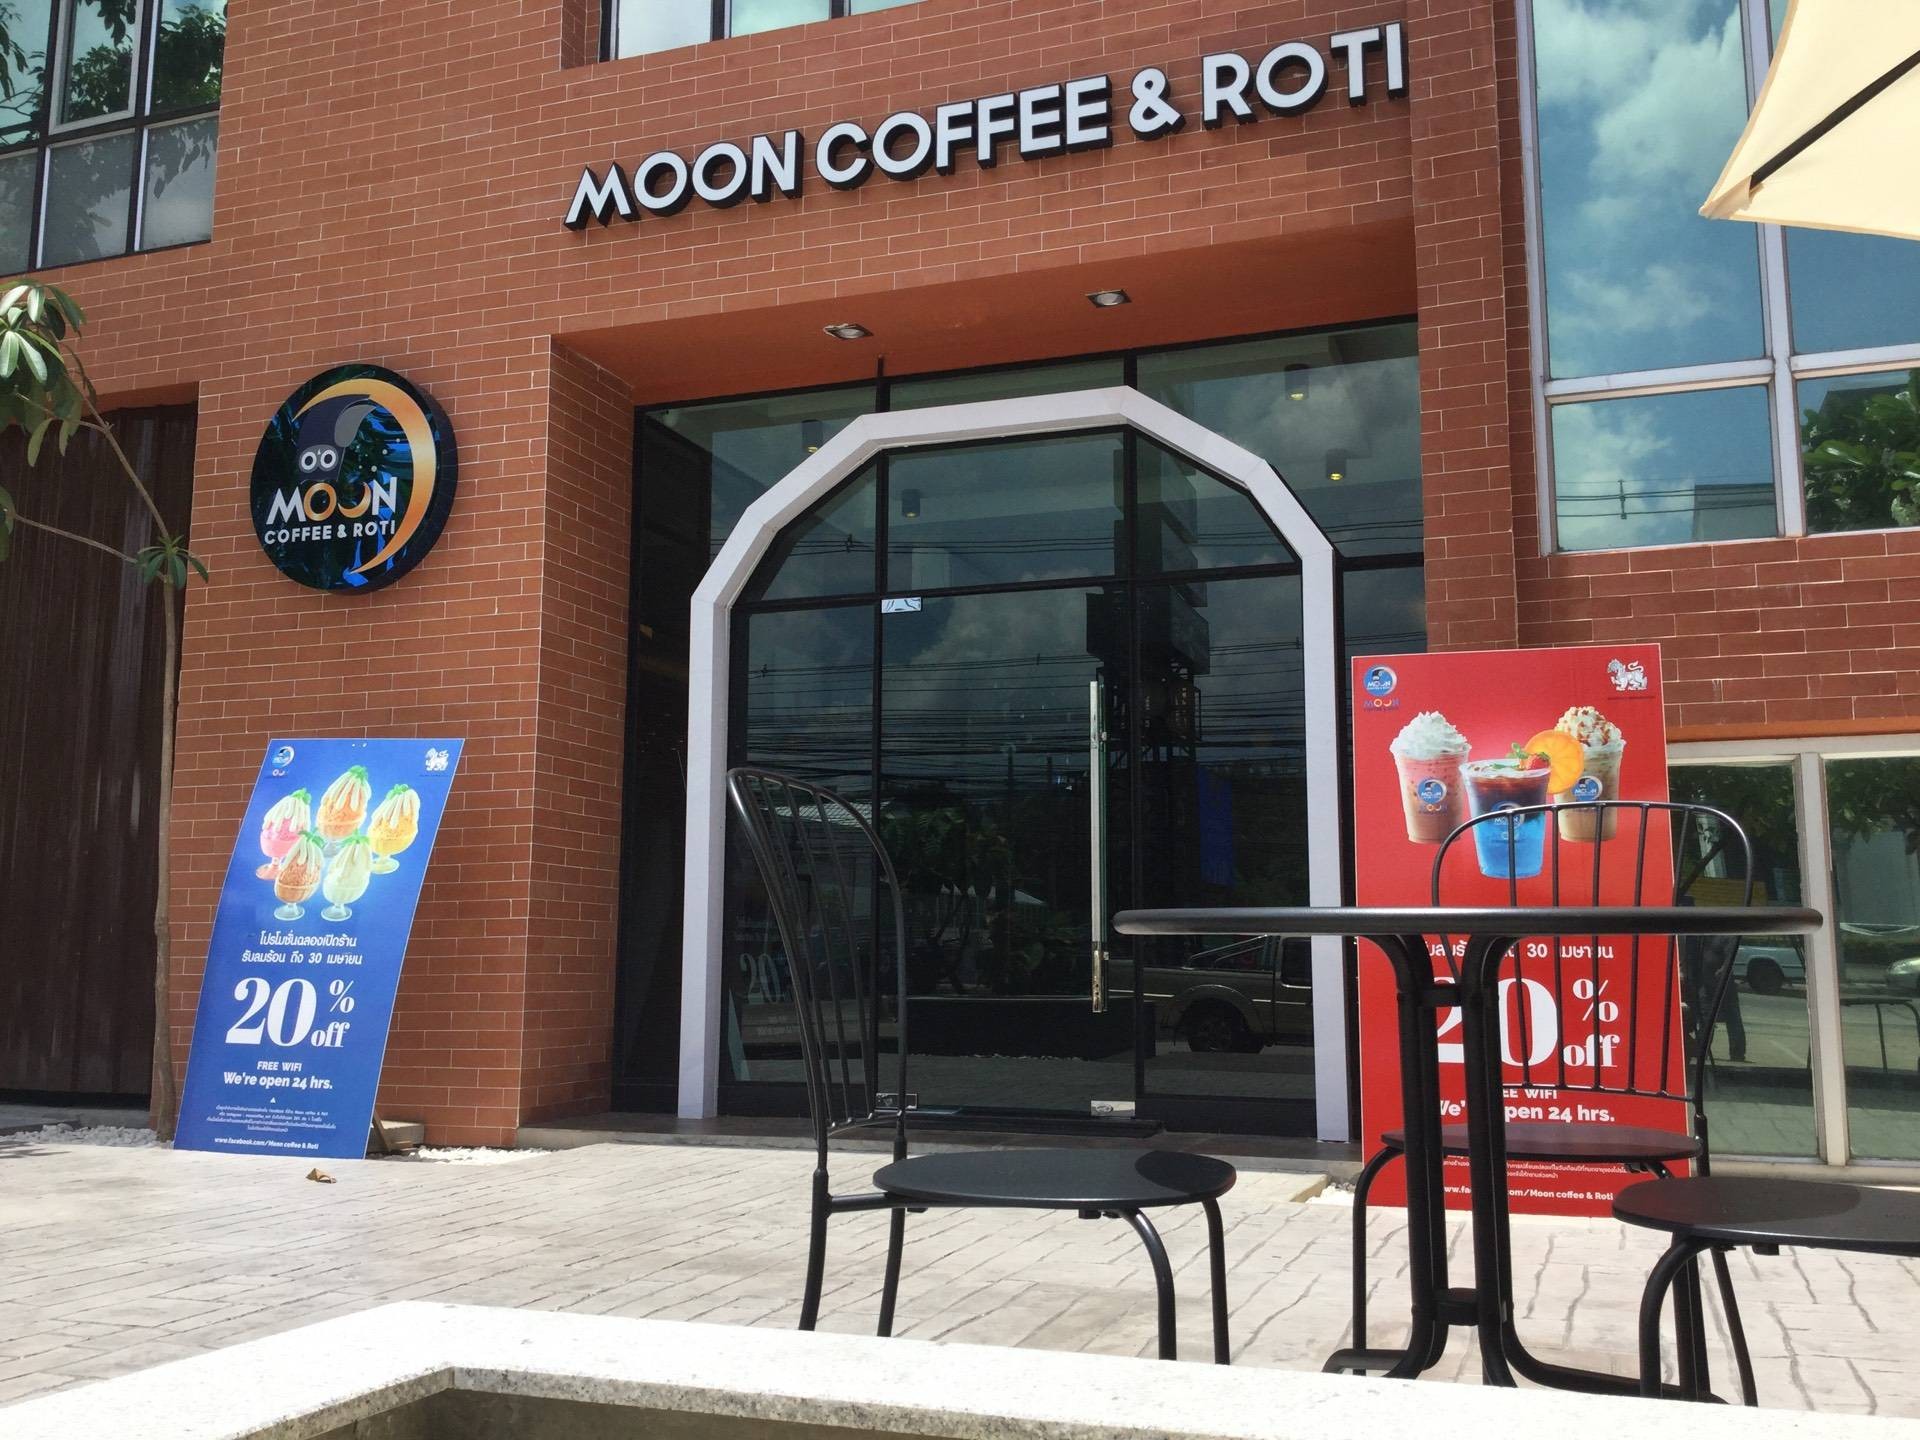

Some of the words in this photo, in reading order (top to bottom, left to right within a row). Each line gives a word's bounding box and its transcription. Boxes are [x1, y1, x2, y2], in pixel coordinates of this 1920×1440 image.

[564, 130, 804, 231] MOON
[815, 74, 1112, 191] COFFEE
[1128, 67, 1186, 140] &
[1202, 21, 1408, 130] ROTI
[266, 476, 398, 525] MOON
[264, 524, 332, 545] COFFEE
[337, 523, 347, 539] &
[353, 519, 395, 538] ROTI
[241, 949, 286, 963] รับลมร้อน
[290, 950, 304, 964] ถึง
[308, 952, 322, 964] 30
[1526, 943, 1548, 958] 30
[1572, 978, 1618, 1022] %
[225, 977, 317, 1047] 20
[329, 979, 355, 1013] %
[310, 1021, 351, 1048] off
[1562, 1034, 1620, 1067] off
[256, 1061, 279, 1071] FREE
[282, 1062, 302, 1072] WIFI
[223, 1071, 257, 1085] We're
[258, 1076, 290, 1089] open
[291, 1077, 307, 1090] 24
[310, 1076, 333, 1090] hrs.
[1524, 1089, 1557, 1099] WIFI
[1504, 1105, 1543, 1122] pen
[1548, 1105, 1573, 1123] 24
[1577, 1104, 1615, 1122] hrs.
[1556, 1189, 1584, 1199] coffee
[1586, 1191, 1593, 1200] &
[1594, 1191, 1614, 1201] Roti
